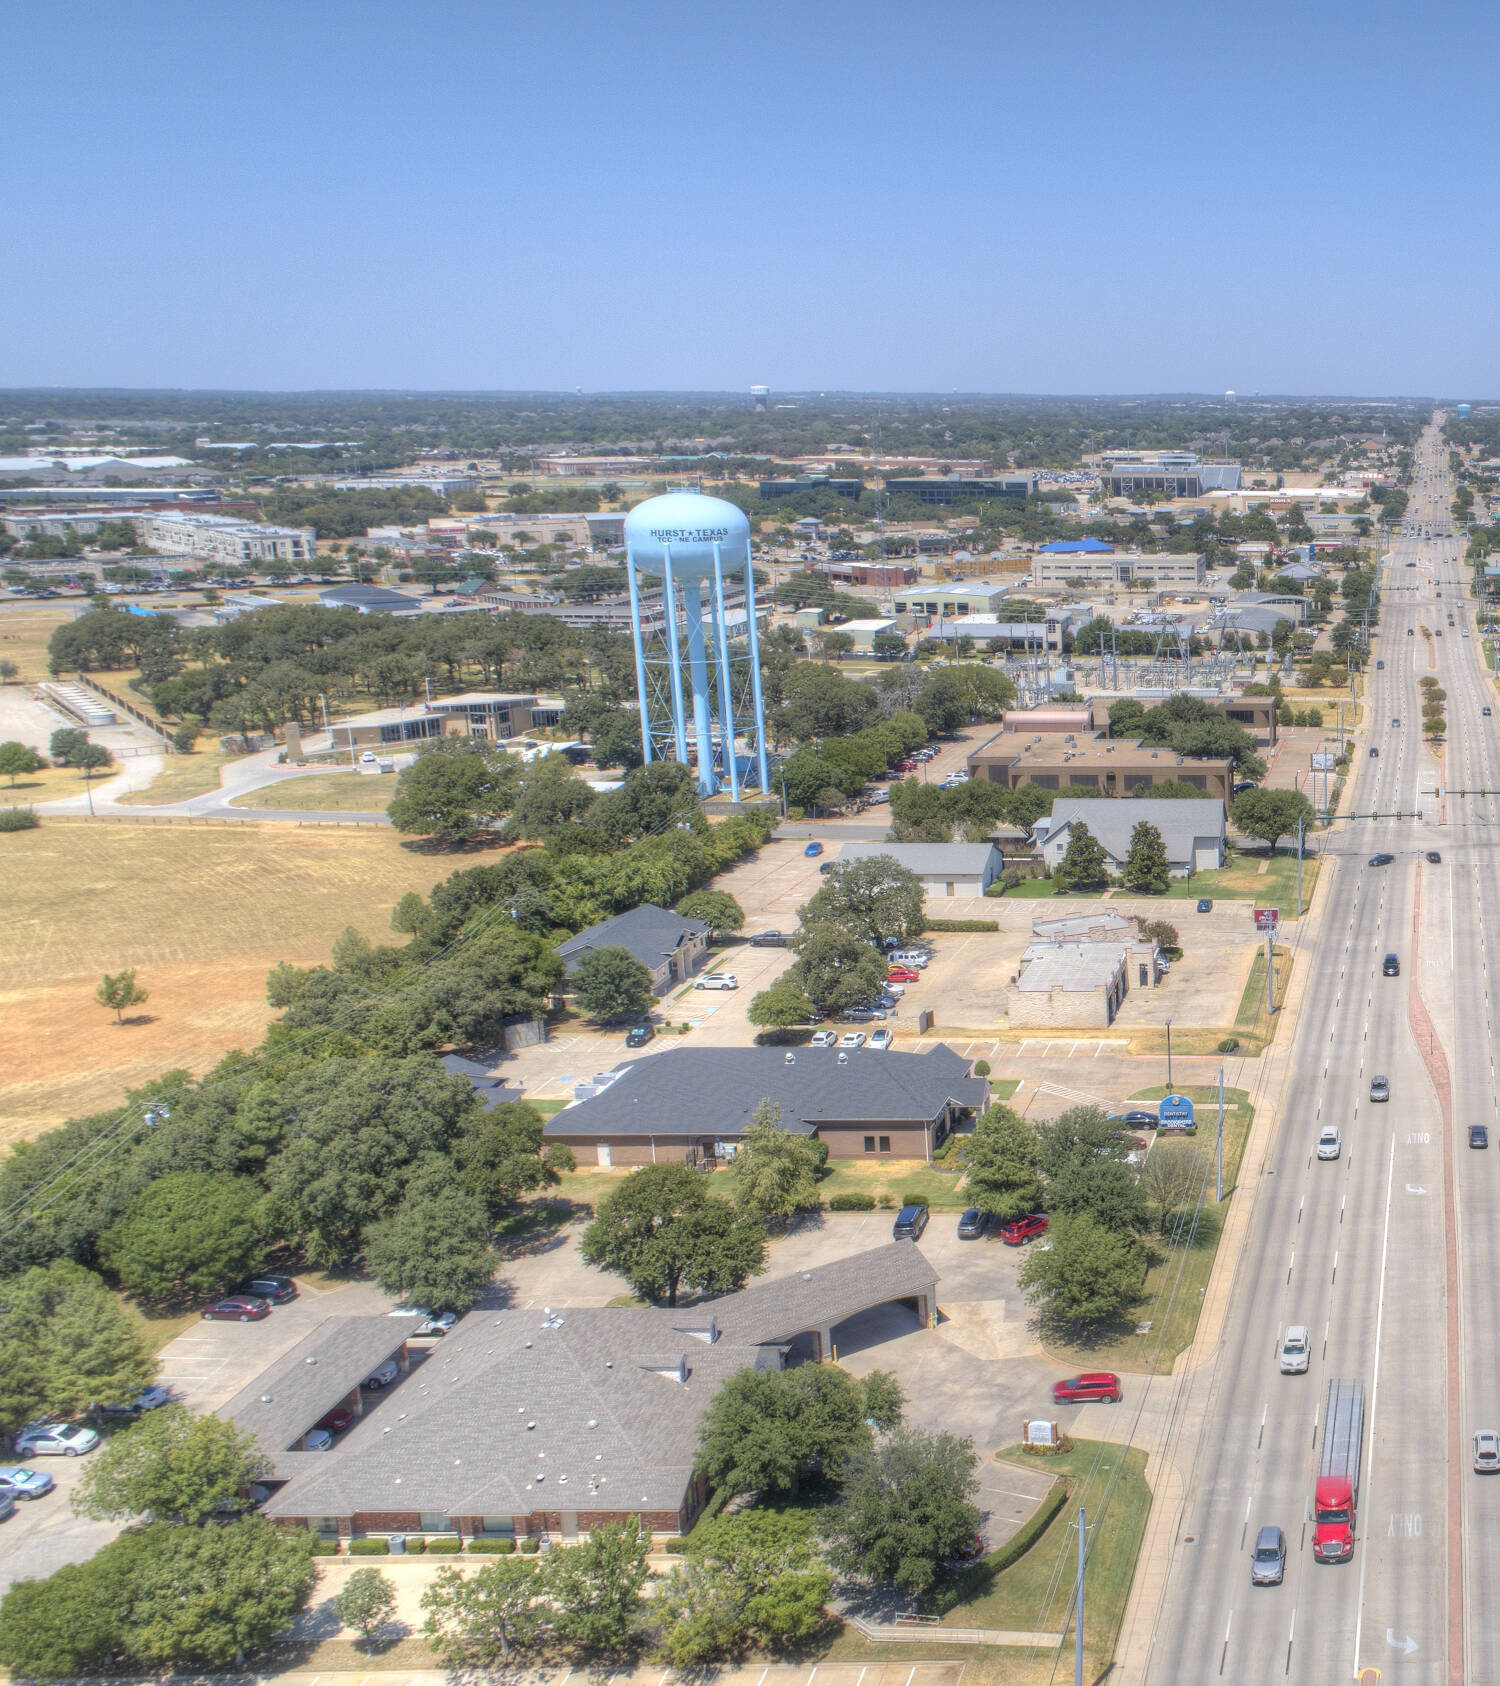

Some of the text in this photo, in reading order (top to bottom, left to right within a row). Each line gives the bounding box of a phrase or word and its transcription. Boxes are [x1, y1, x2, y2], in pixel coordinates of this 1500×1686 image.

[650, 528, 729, 537] HURST TEXAS
[692, 535, 724, 543] CAMPUS
[1408, 1132, 1431, 1145] ONLY
